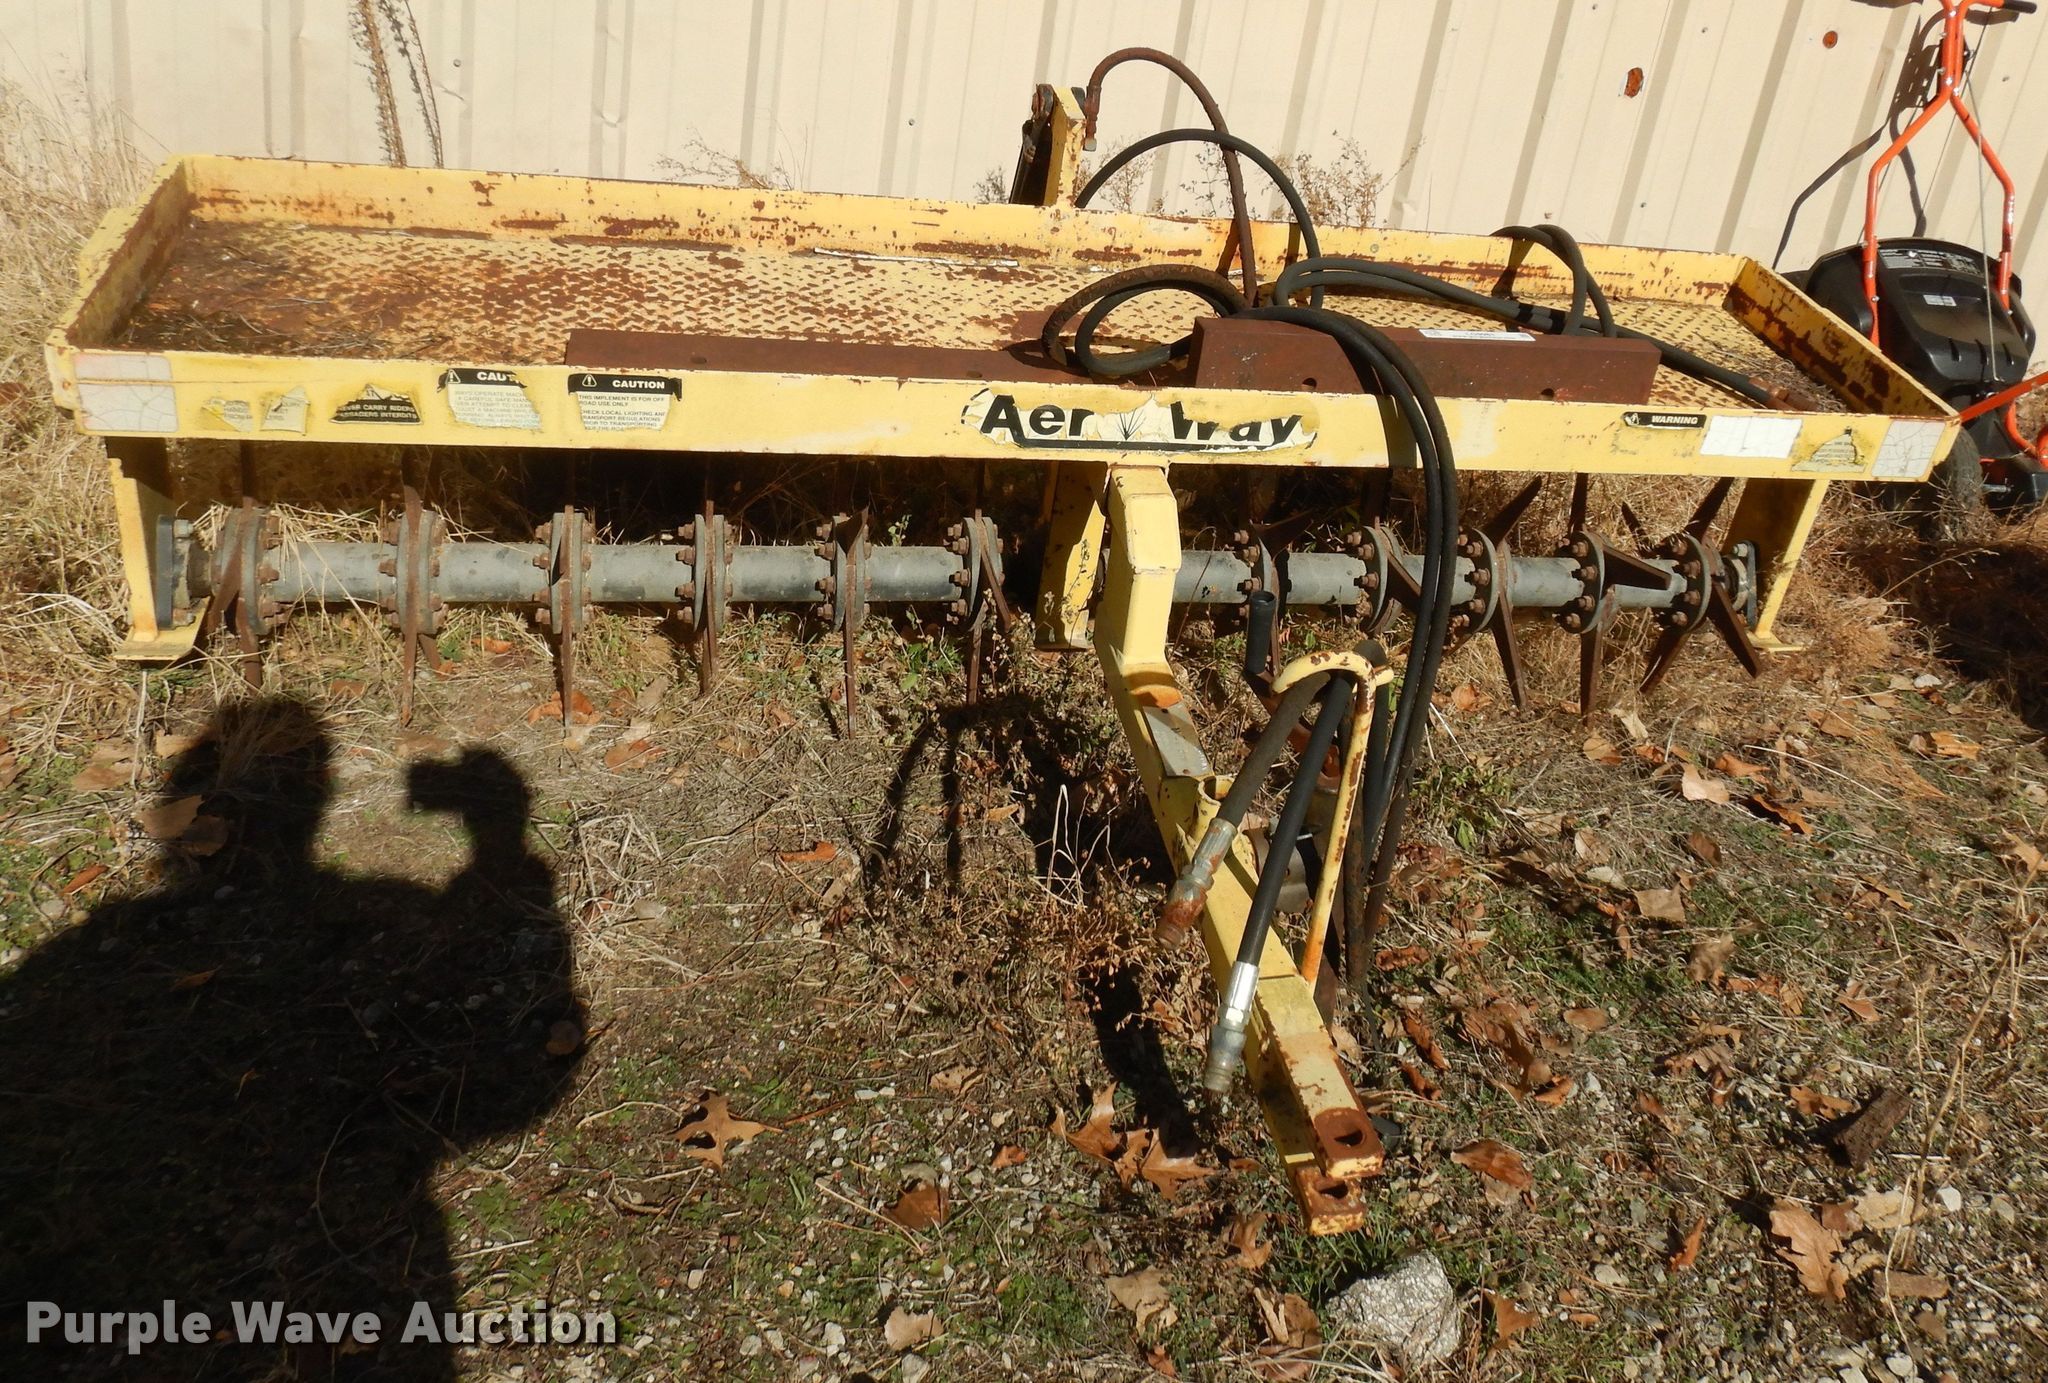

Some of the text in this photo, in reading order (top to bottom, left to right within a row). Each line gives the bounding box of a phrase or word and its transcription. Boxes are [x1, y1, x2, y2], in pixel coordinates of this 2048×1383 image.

[612, 379, 665, 389] CAUTION
[980, 394, 1096, 438] Aer
[1651, 415, 1698, 425] WARNING
